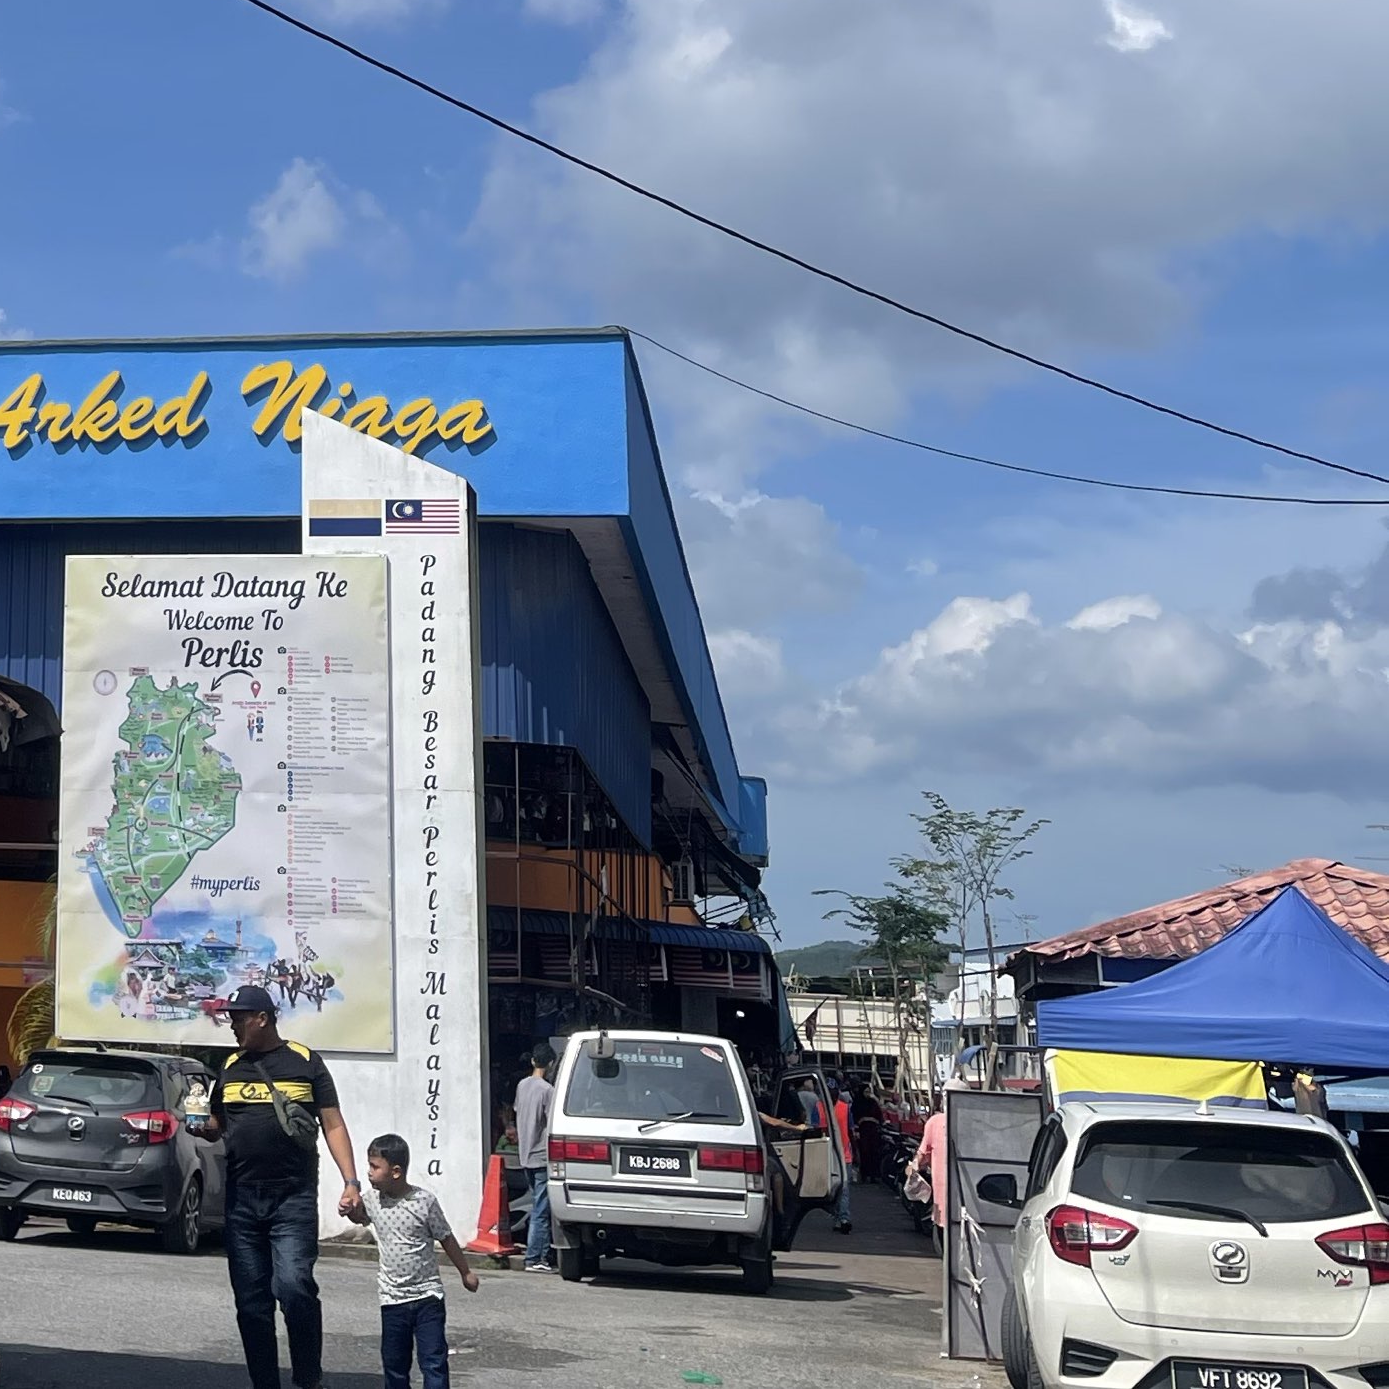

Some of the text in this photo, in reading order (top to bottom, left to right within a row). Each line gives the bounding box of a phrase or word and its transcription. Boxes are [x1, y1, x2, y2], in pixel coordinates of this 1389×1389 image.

[241, 361, 494, 454] Niaga
[101, 571, 348, 610] Selamat Datang Ke
[163, 609, 284, 631] Welcome To
[181, 637, 264, 668] Perlis
[419, 554, 448, 1178] Padang Besar Perlis Malaysia
[189, 874, 261, 898] #myperlis
[629, 1155, 680, 1170] KBJ 2688
[1198, 1367, 1283, 1389] VFT 8692
